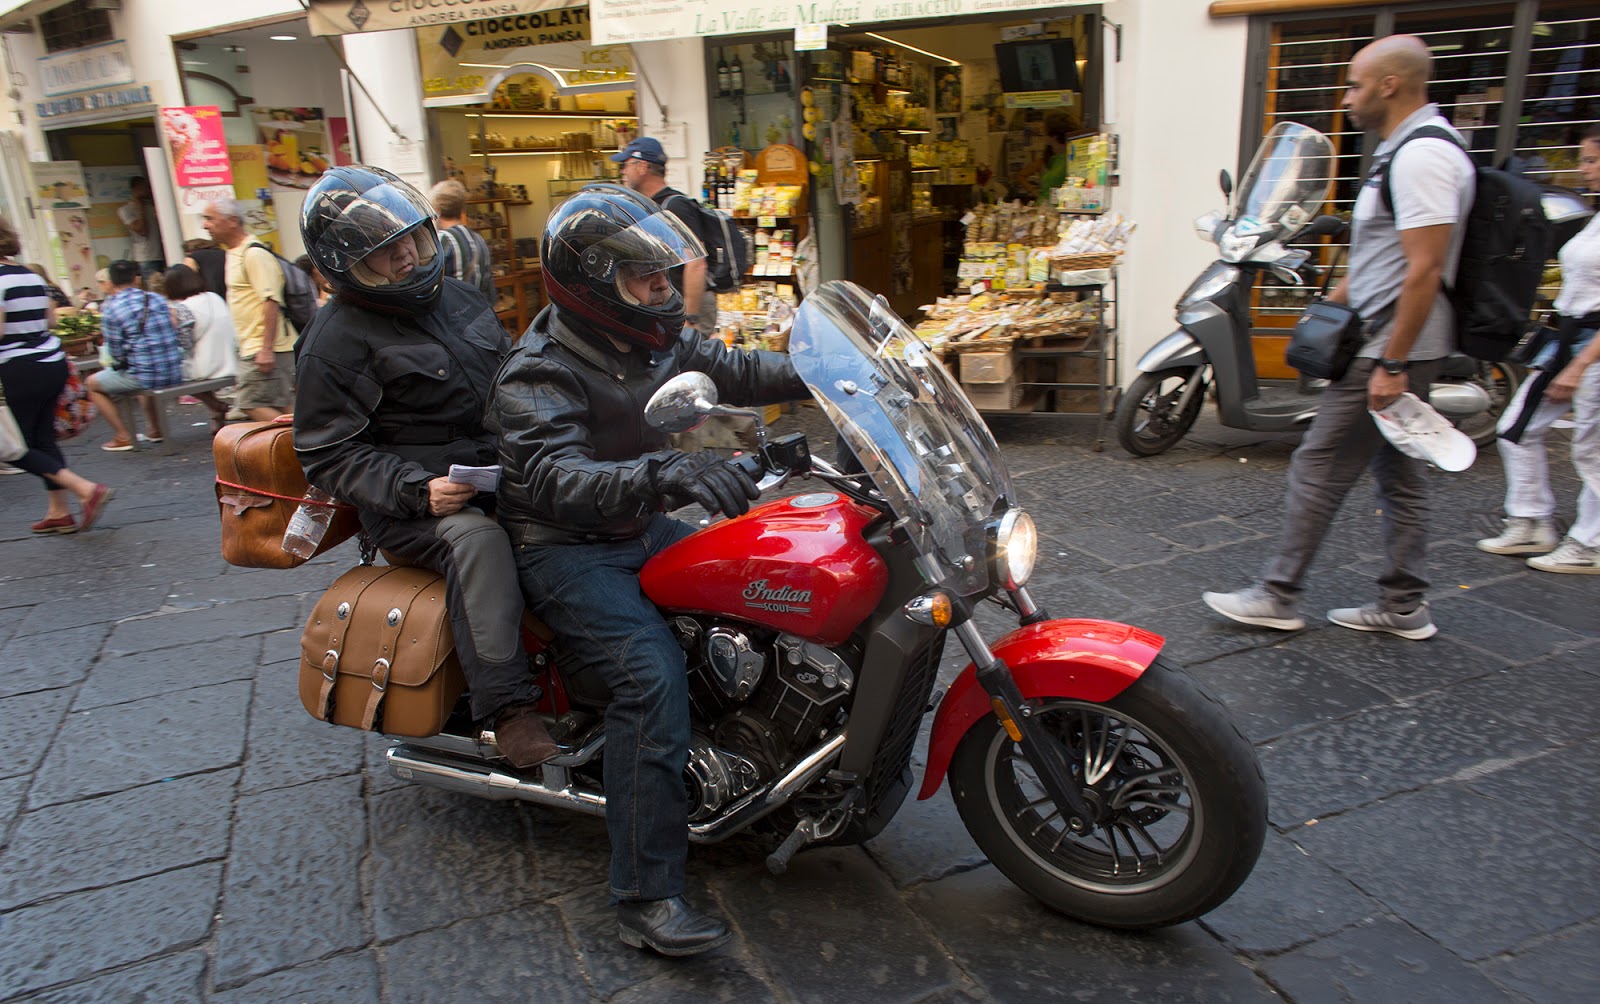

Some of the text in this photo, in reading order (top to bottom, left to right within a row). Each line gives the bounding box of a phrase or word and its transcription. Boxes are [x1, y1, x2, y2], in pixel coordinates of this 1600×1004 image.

[408, 4, 519, 25] ANDREA PANSA
[915, 0, 962, 15] ACETO
[696, 14, 717, 34] La
[722, 8, 765, 32] Valle
[483, 30, 585, 50] ANDREA PANSA
[582, 49, 612, 65] ICE
[424, 75, 485, 92] GELATO
[742, 579, 813, 603] Indian
[763, 602, 791, 613] SCOUT
